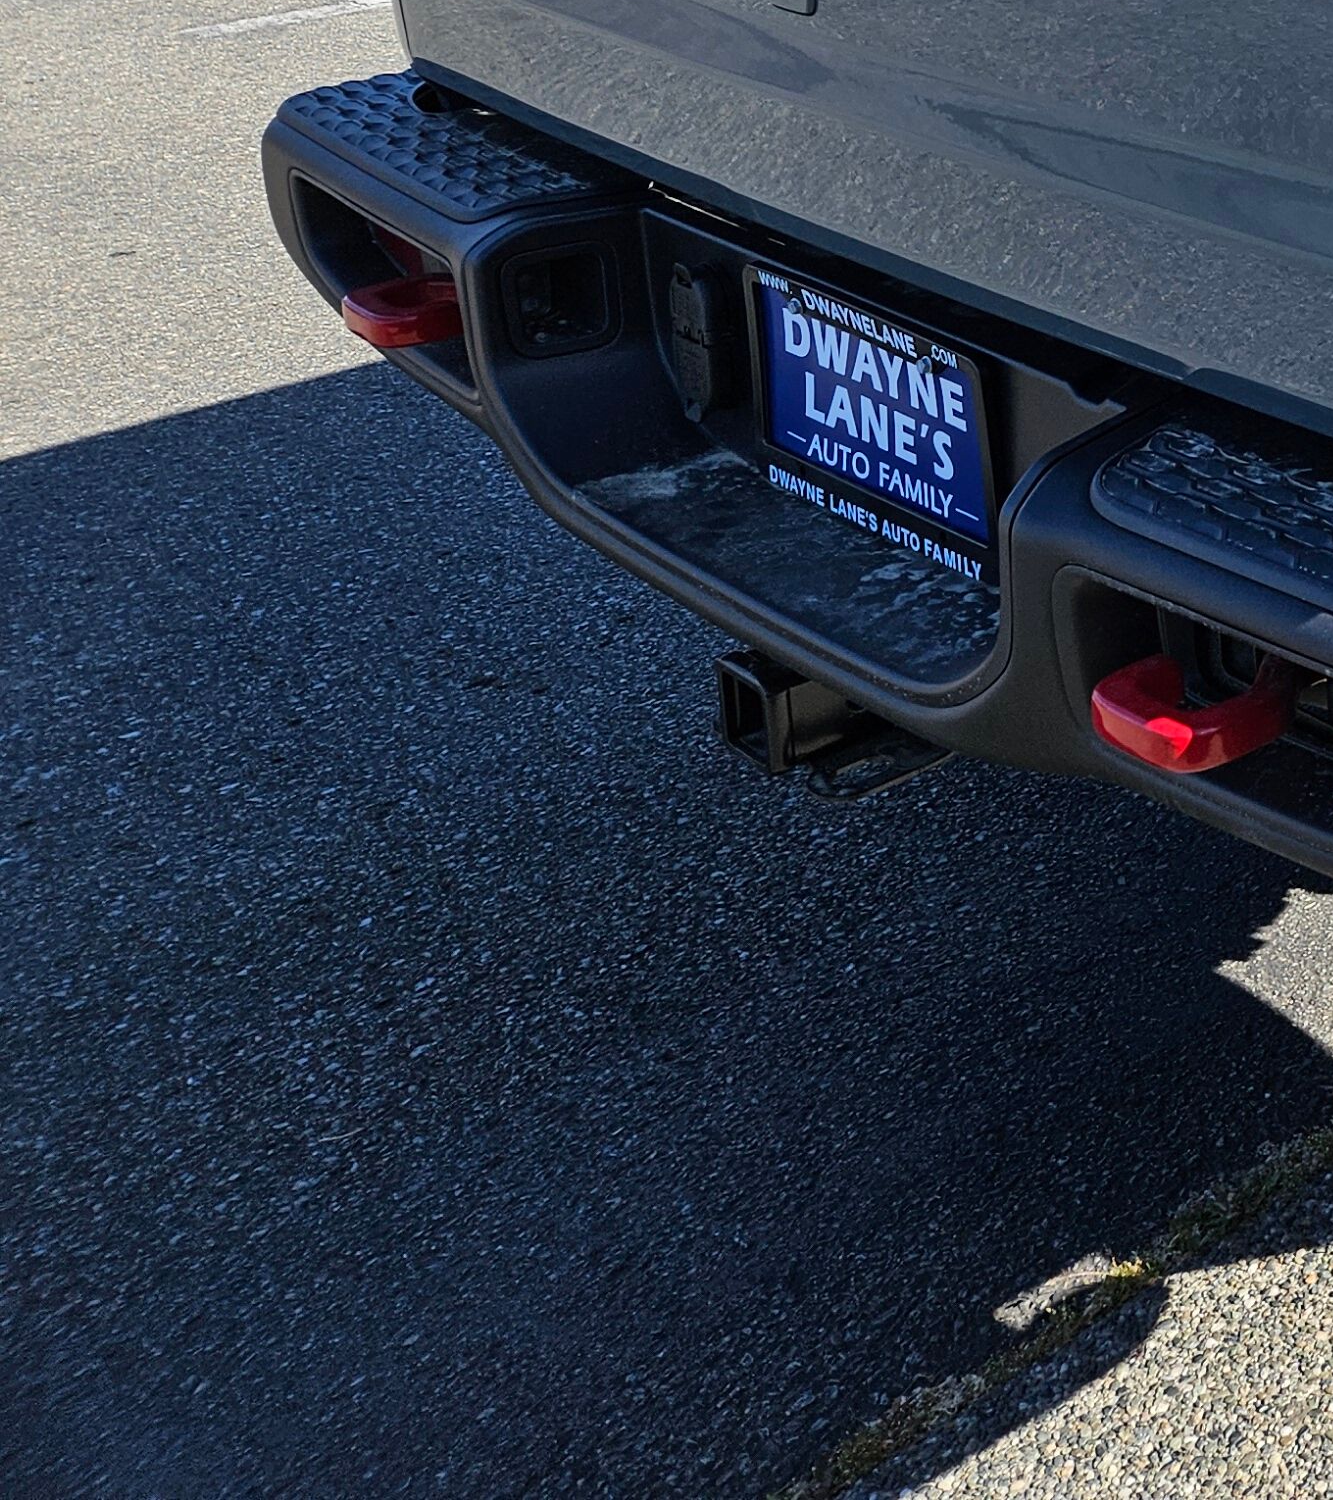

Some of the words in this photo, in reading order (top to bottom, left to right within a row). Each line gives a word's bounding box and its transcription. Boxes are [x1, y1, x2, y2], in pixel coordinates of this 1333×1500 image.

[783, 306, 967, 433] DWAYNE
[800, 288, 918, 358] DWAYNELANE
[804, 372, 955, 482] LANE'S
[807, 434, 870, 480] AUTO
[879, 462, 954, 519] FAMILY
[769, 464, 825, 508] DWAYNE
[829, 493, 878, 533] LANE'S
[881, 519, 920, 553] AUTO
[923, 541, 982, 581] FAMILY
